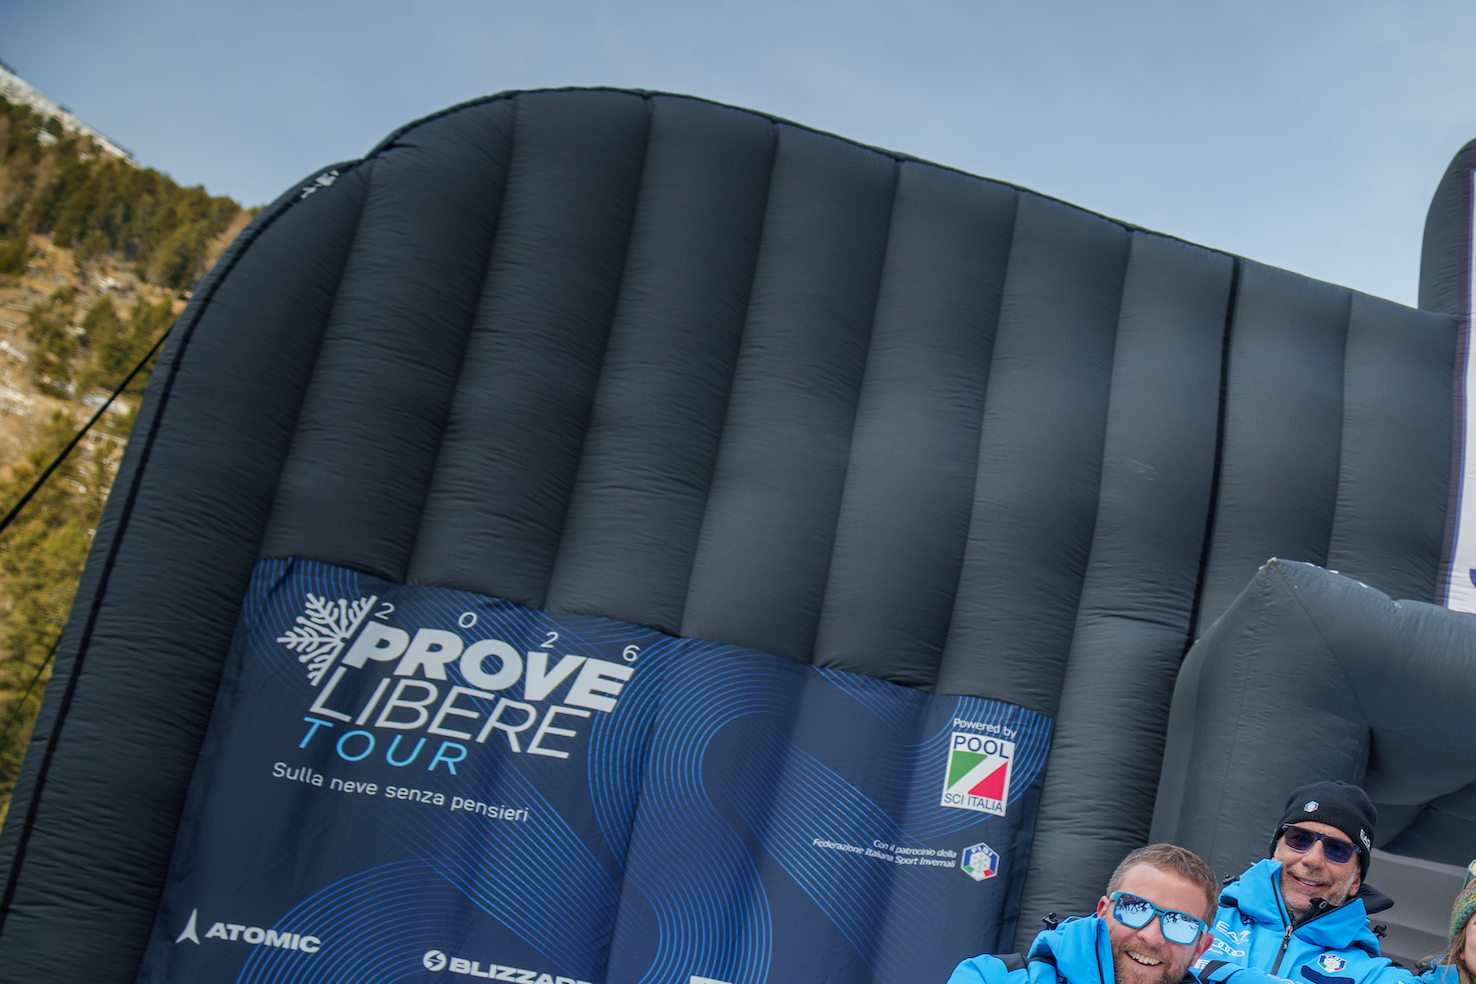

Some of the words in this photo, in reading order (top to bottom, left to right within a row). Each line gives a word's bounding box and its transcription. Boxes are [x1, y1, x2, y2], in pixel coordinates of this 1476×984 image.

[342, 621, 634, 712] PROVE
[310, 666, 591, 759] LIBERE
[953, 718, 1000, 734] Powered
[1003, 724, 1017, 738] by
[299, 716, 468, 775] TOUR
[953, 735, 1009, 759] POOL
[272, 761, 323, 786] Sulla
[330, 777, 378, 795] neve
[385, 783, 445, 805] senza
[450, 796, 529, 822] pensieri
[944, 792, 964, 805] SCI
[967, 796, 1003, 813] ITALIA
[812, 838, 864, 855] Federazione
[865, 847, 894, 862] Italiana
[895, 855, 918, 866] Sport
[919, 858, 956, 868] Invernali
[873, 839, 888, 849] Con
[889, 842, 895, 852] il
[895, 845, 935, 856] patrocinio
[937, 850, 957, 859] della
[205, 922, 321, 954] ATOMIC
